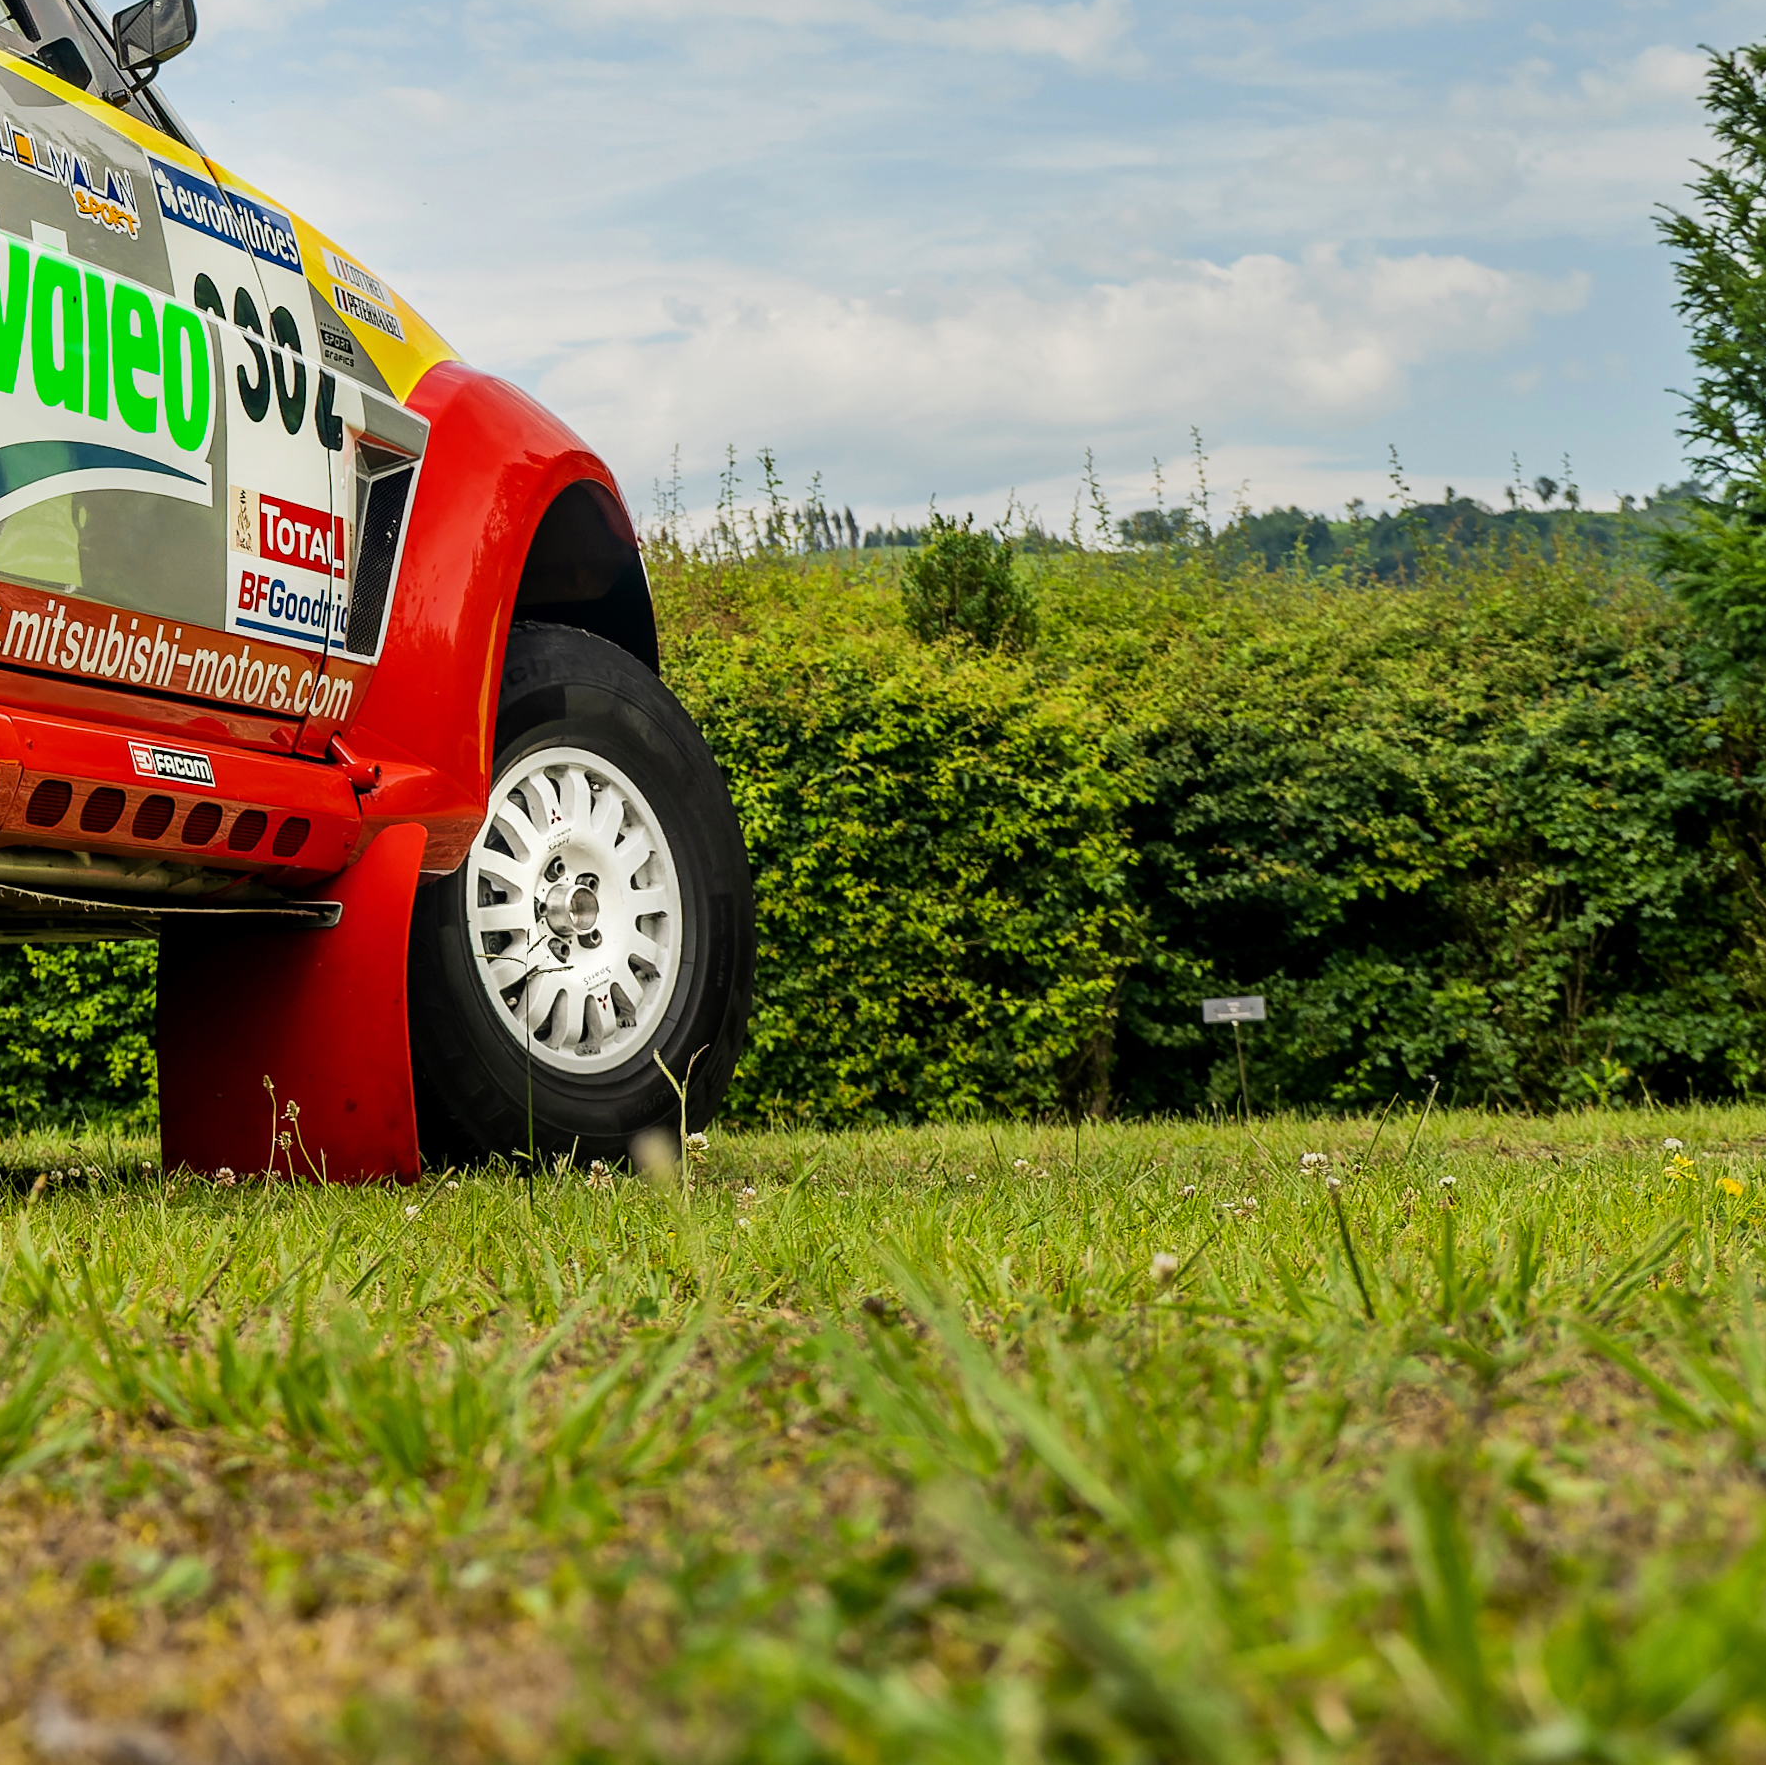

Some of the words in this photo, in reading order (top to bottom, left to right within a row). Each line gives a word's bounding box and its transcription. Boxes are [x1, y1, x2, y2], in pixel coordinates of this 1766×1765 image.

[75, 190, 138, 236] SPORT
[260, 502, 345, 571] TOTAL
[154, 753, 211, 781] FACOM
